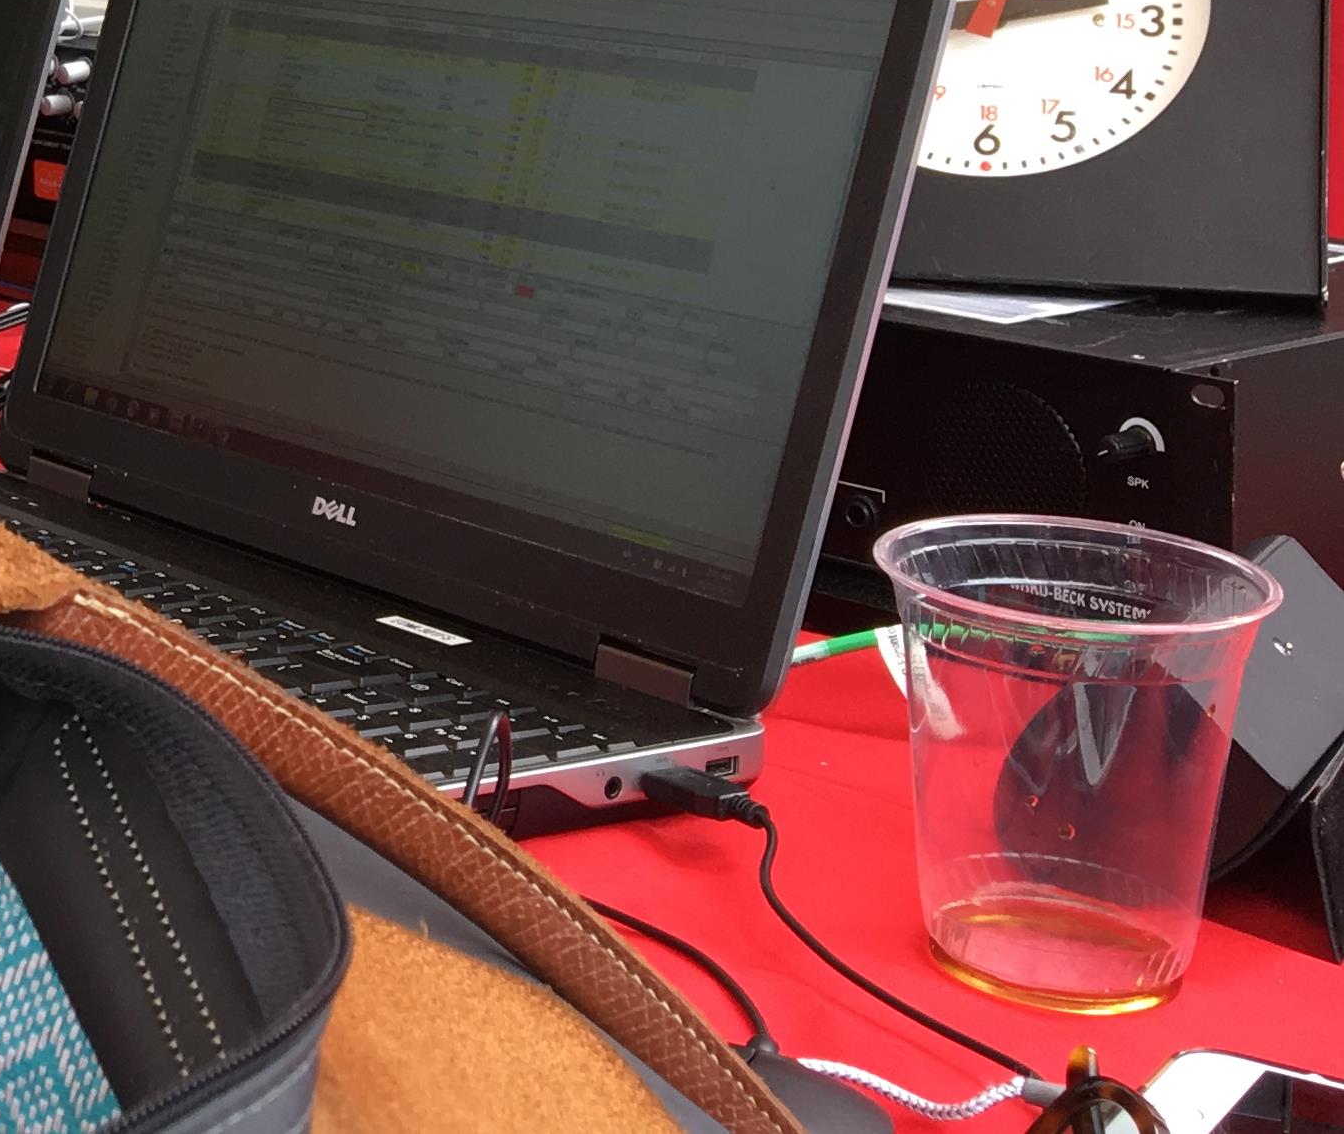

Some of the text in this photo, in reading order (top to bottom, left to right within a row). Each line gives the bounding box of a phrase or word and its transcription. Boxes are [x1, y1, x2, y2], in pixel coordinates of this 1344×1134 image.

[1115, 13, 1136, 31] 15
[1139, 4, 1166, 38] 3
[1094, 66, 1115, 83] 16
[1109, 68, 1137, 100] 4
[933, 84, 947, 101] 9
[980, 104, 999, 122] 18
[1040, 98, 1061, 116] 17
[1050, 110, 1077, 144] 5
[973, 124, 1001, 157] 6
[1127, 475, 1150, 490] SPK
[312, 496, 357, 527] DELL
[1089, 595, 1152, 620] SYSTEM
